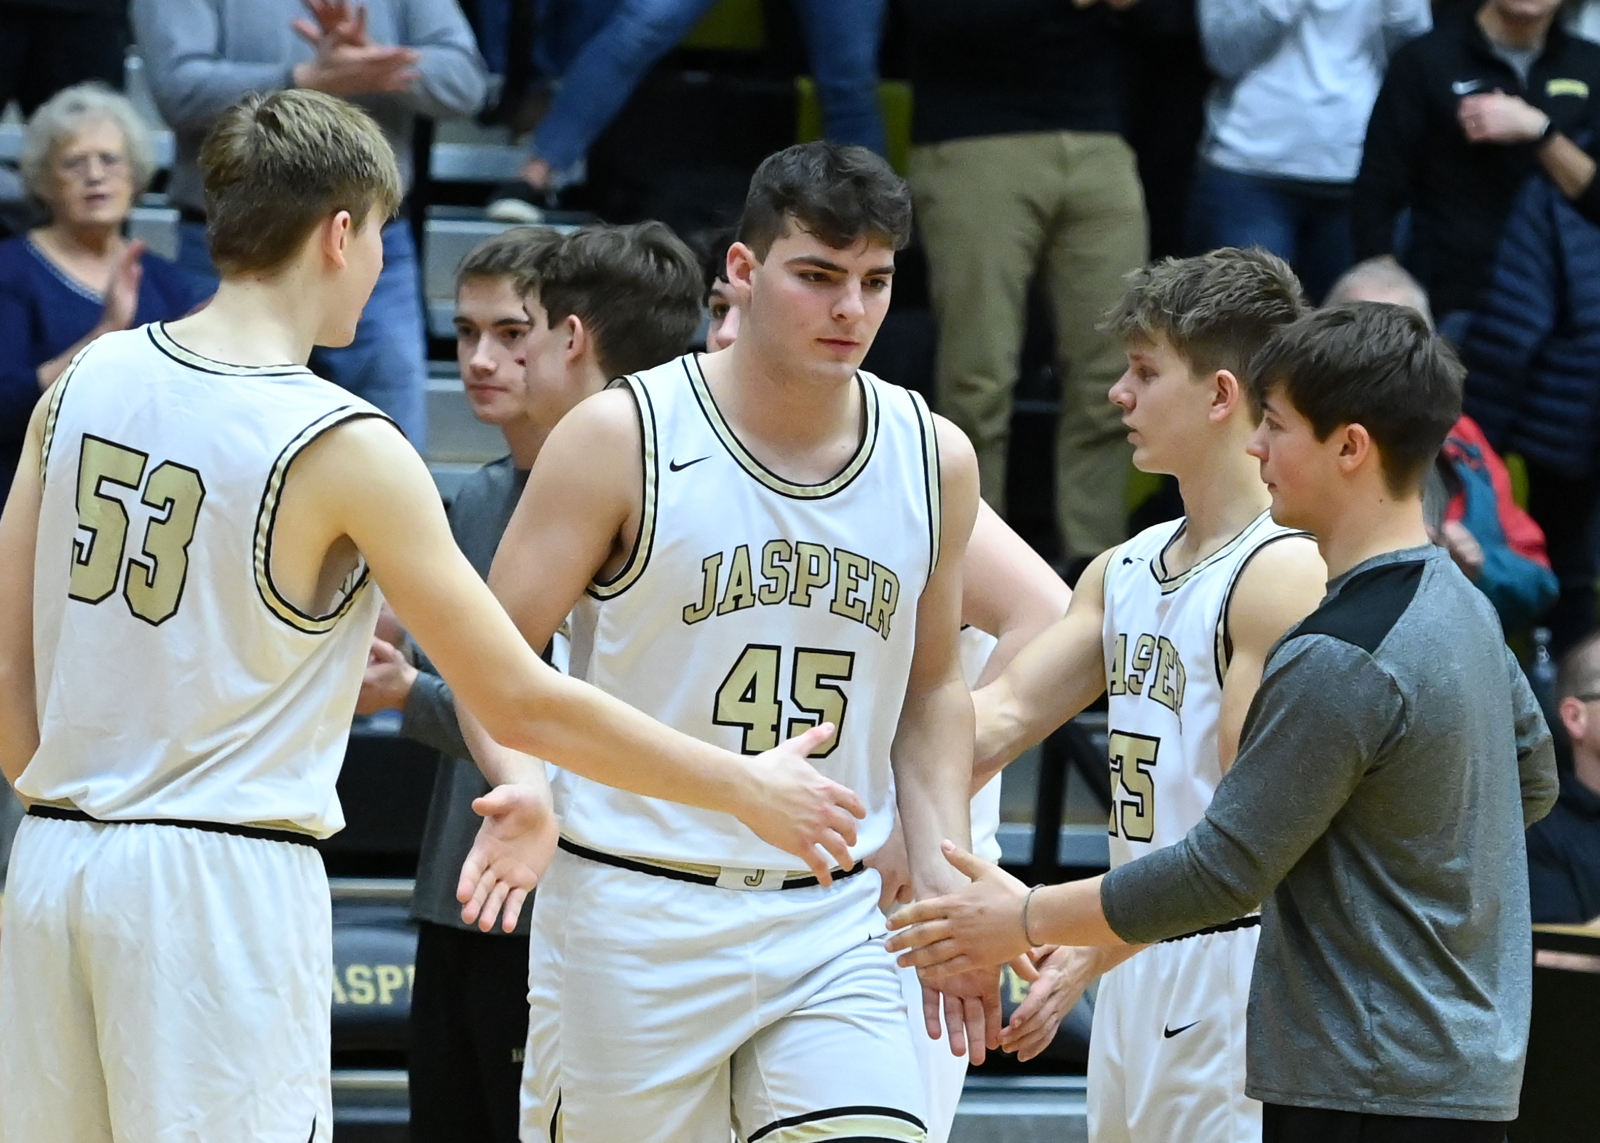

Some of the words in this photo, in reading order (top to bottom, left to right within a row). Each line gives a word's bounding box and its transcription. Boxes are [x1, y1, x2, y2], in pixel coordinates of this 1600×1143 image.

[68, 432, 207, 627] 53
[682, 538, 901, 641] JASPER
[712, 643, 856, 759] 45
